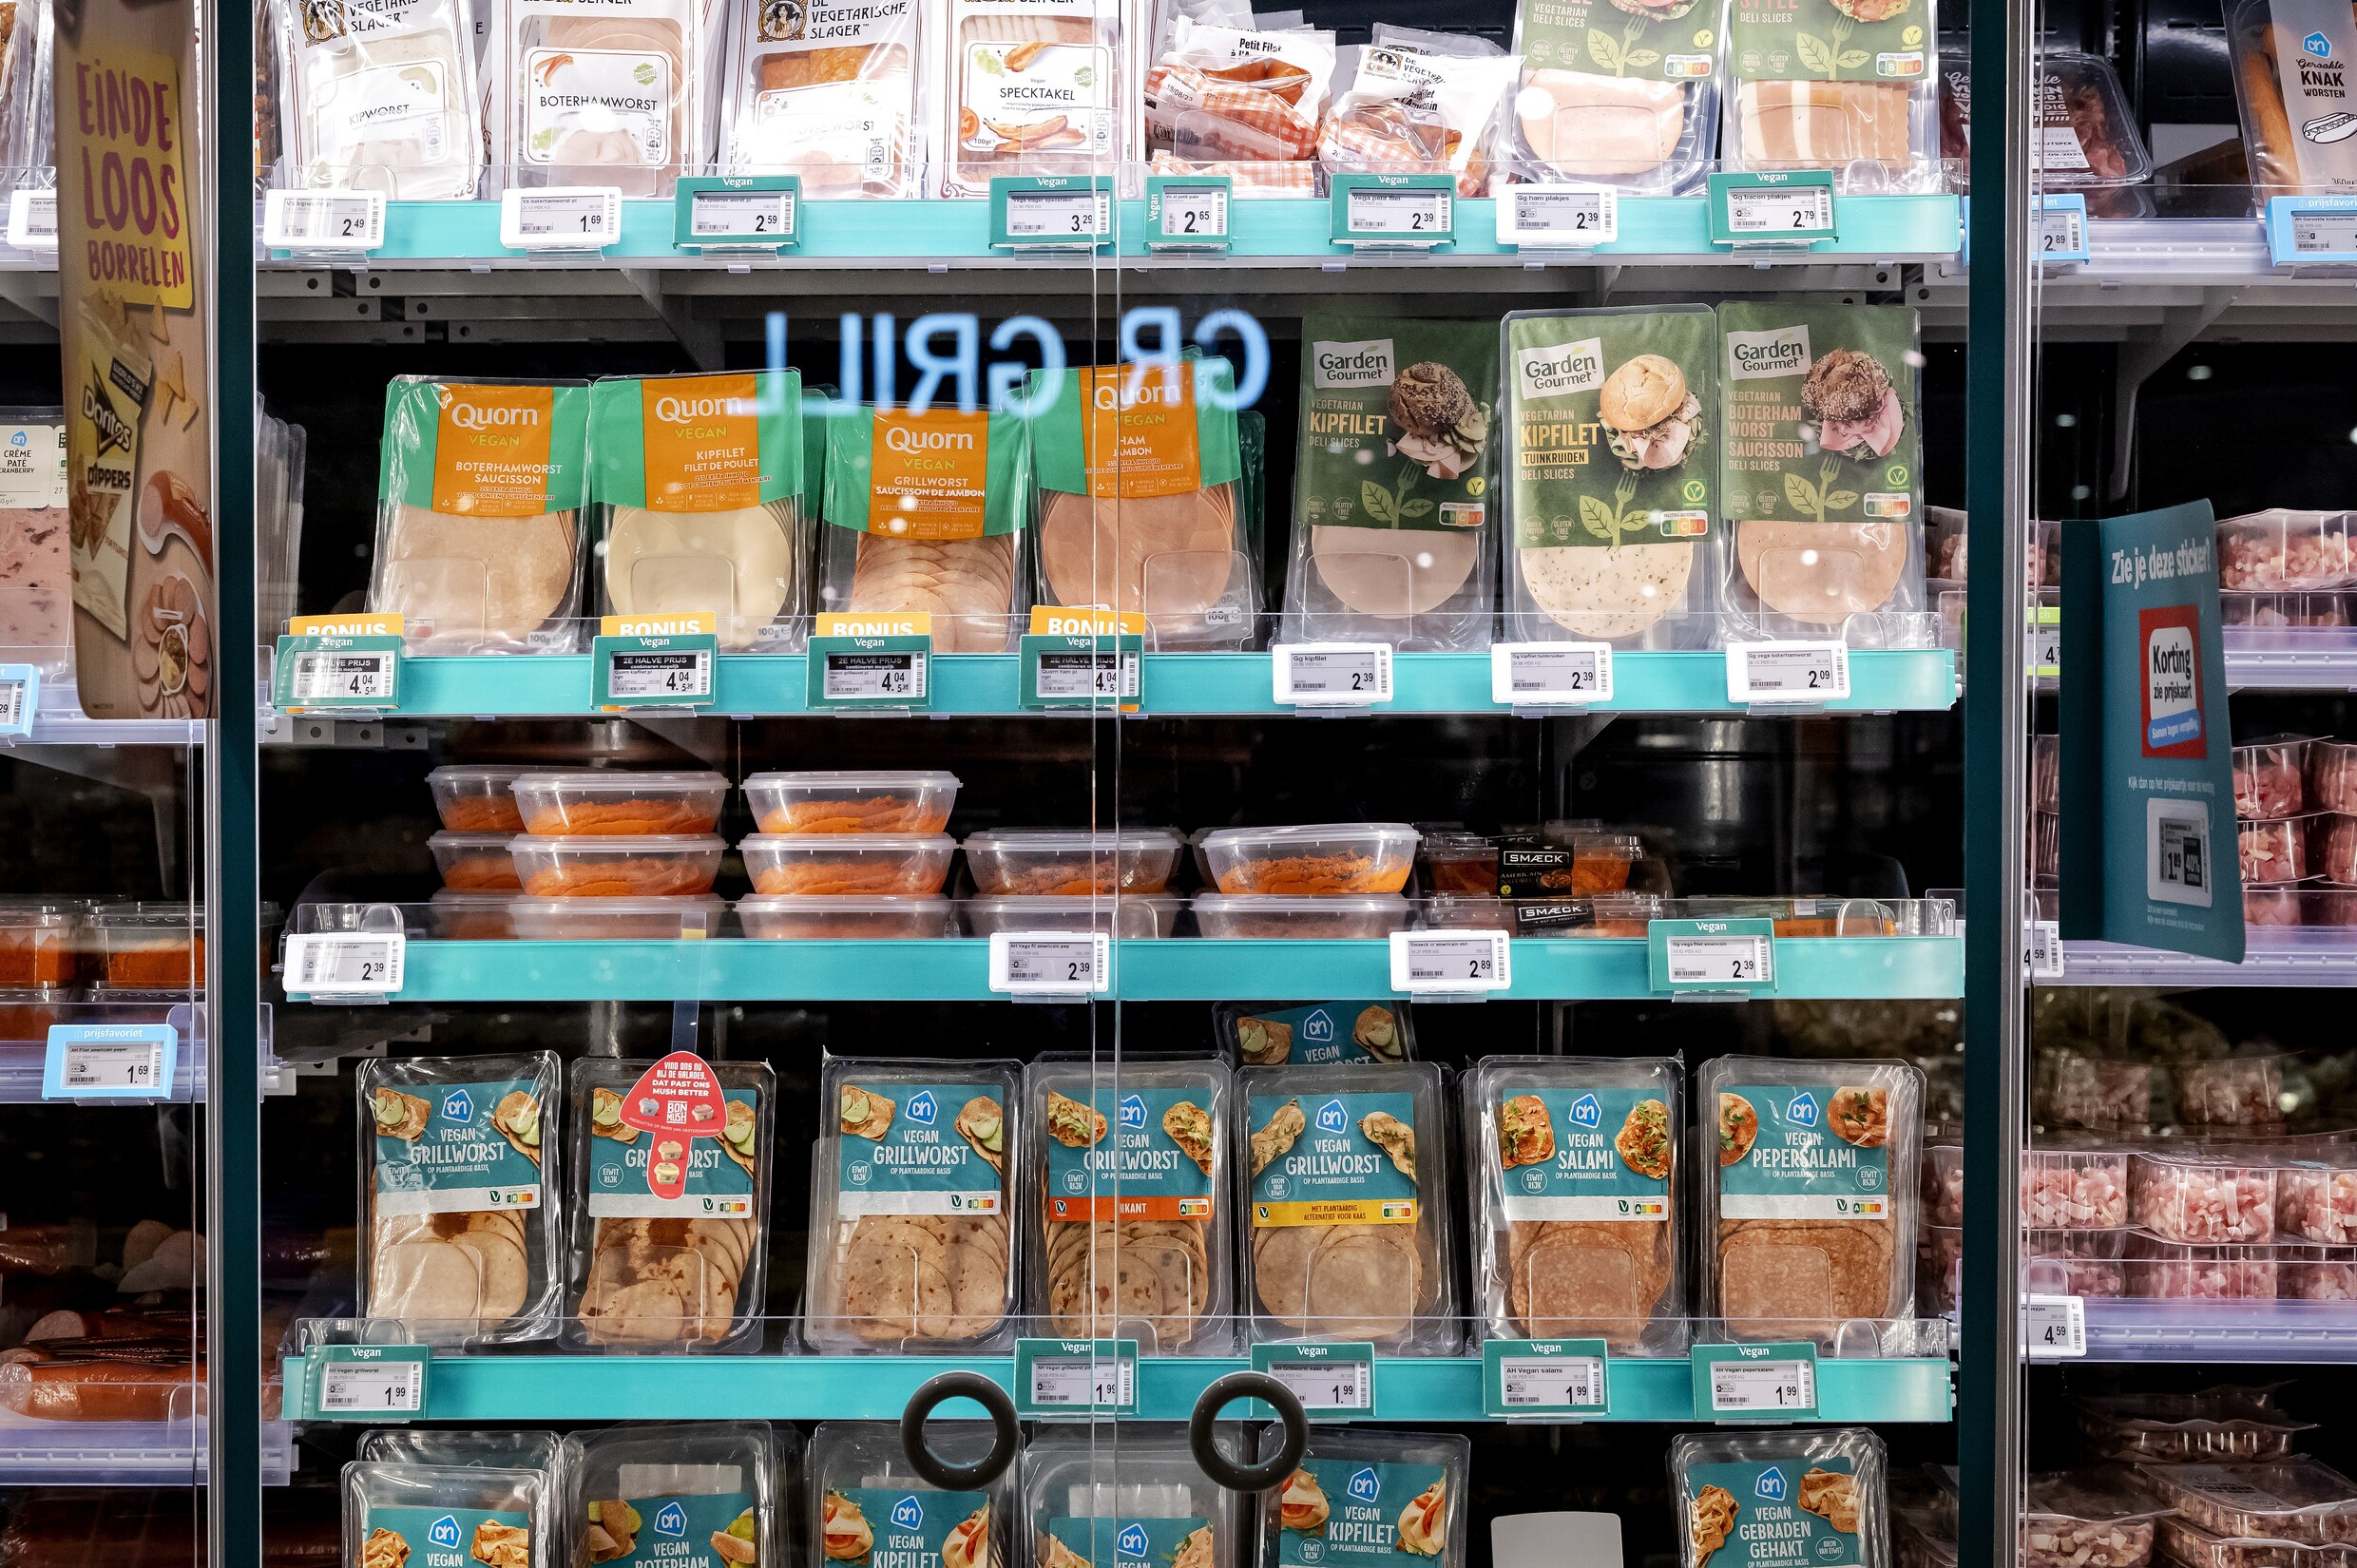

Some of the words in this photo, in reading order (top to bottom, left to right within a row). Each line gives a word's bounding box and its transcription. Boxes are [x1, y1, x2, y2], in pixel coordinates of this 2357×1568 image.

[812, 1, 908, 24] VEGETARISCHE
[1535, 5, 1588, 18] VEGETARIAN
[1740, 11, 1762, 22] DELI
[1765, 12, 1792, 23] SLICES
[1239, 38, 1260, 51] Petit
[2296, 57, 2345, 71] Gerookte
[2301, 70, 2345, 87] KNAK
[1000, 86, 1075, 101] SPECKTAKEL
[2304, 87, 2346, 98] WORSTEN
[540, 95, 658, 110] BOTERHAMWORST
[349, 104, 410, 125] KIPWORST
[722, 178, 753, 187] Vegan
[1037, 178, 1066, 186] Vegan
[1378, 176, 1408, 185] Vegan
[1756, 172, 1787, 183] Vegan
[82, 146, 181, 239] LOOS
[1149, 194, 1159, 221] Vegan
[88, 239, 184, 288] BORRELEN
[1734, 340, 1803, 363] Garden
[1319, 352, 1388, 373] Garden
[1525, 354, 1596, 379] Garden
[451, 402, 538, 430] Quorn
[655, 397, 743, 425] Quorn
[1521, 411, 1575, 421] VEGETARIAN
[1729, 405, 1801, 421] BOTERHAM
[82, 385, 132, 452] Doritos
[1310, 412, 1386, 435] KIPFILET
[675, 426, 727, 439] VEGAN
[1520, 424, 1599, 446] KIPFILET
[1729, 422, 1774, 437] WORST
[468, 433, 520, 447] VEGAN
[885, 427, 973, 454] Quorn
[4, 449, 31, 458] CRÈME
[696, 448, 745, 460] KIPFILET
[1729, 441, 1803, 457] SAUCISSON
[7, 457, 27, 468] PATÉ
[903, 458, 956, 470] VEGAN
[1524, 452, 1586, 464] TUINKRUIDEN
[455, 462, 563, 475] BOTERHAMWORST
[684, 462, 708, 472] FILET
[711, 461, 722, 470] DE
[725, 459, 759, 469] POULET
[1729, 461, 1747, 470] DELI
[1749, 461, 1779, 470] SLICES
[86, 463, 131, 492] DIPPERS
[474, 473, 541, 485] SAUCISSON
[893, 477, 968, 487] GRILLWORST
[876, 487, 929, 496] SAUCISSON
[945, 488, 986, 497] JAMBON
[2112, 551, 2133, 584] Zie
[2136, 550, 2146, 589] je
[2149, 545, 2175, 580] deze
[2176, 539, 2211, 576] sticker?
[620, 621, 699, 634] BONUS
[640, 637, 670, 648] Vegan
[854, 638, 884, 649] Vegan
[2154, 644, 2192, 679] Korting
[2165, 682, 2192, 703] prijskaart
[1696, 922, 1726, 932] Vegan
[84, 1028, 143, 1040] prijsfavoriet
[667, 1103, 687, 1113] BON
[667, 1113, 687, 1121] MUSH
[440, 1128, 476, 1142] VEGAN
[904, 1130, 939, 1143] VEGAN
[1568, 1134, 1603, 1147] VEGAN
[1785, 1133, 1822, 1146] VEGAN
[1314, 1138, 1351, 1153] VEGAN
[410, 1142, 506, 1164] GRILLWORST
[873, 1145, 968, 1165] GRILLWORST
[1558, 1150, 1614, 1169] SALAMI
[1753, 1149, 1856, 1168] PEPERSALAMI
[1285, 1155, 1381, 1176] GRILLWORST
[351, 1348, 381, 1359] Vegan
[1296, 1347, 1327, 1357] Vegan
[1531, 1343, 1562, 1353] Vegan
[1738, 1347, 1769, 1357] Vegan
[1345, 1506, 1380, 1520] VEGAN
[1755, 1507, 1792, 1520] VEGAN
[1330, 1522, 1394, 1543] KIPFILET
[1739, 1523, 1811, 1539] GEBRADEN
[1750, 1542, 1803, 1558] GEHAKT
